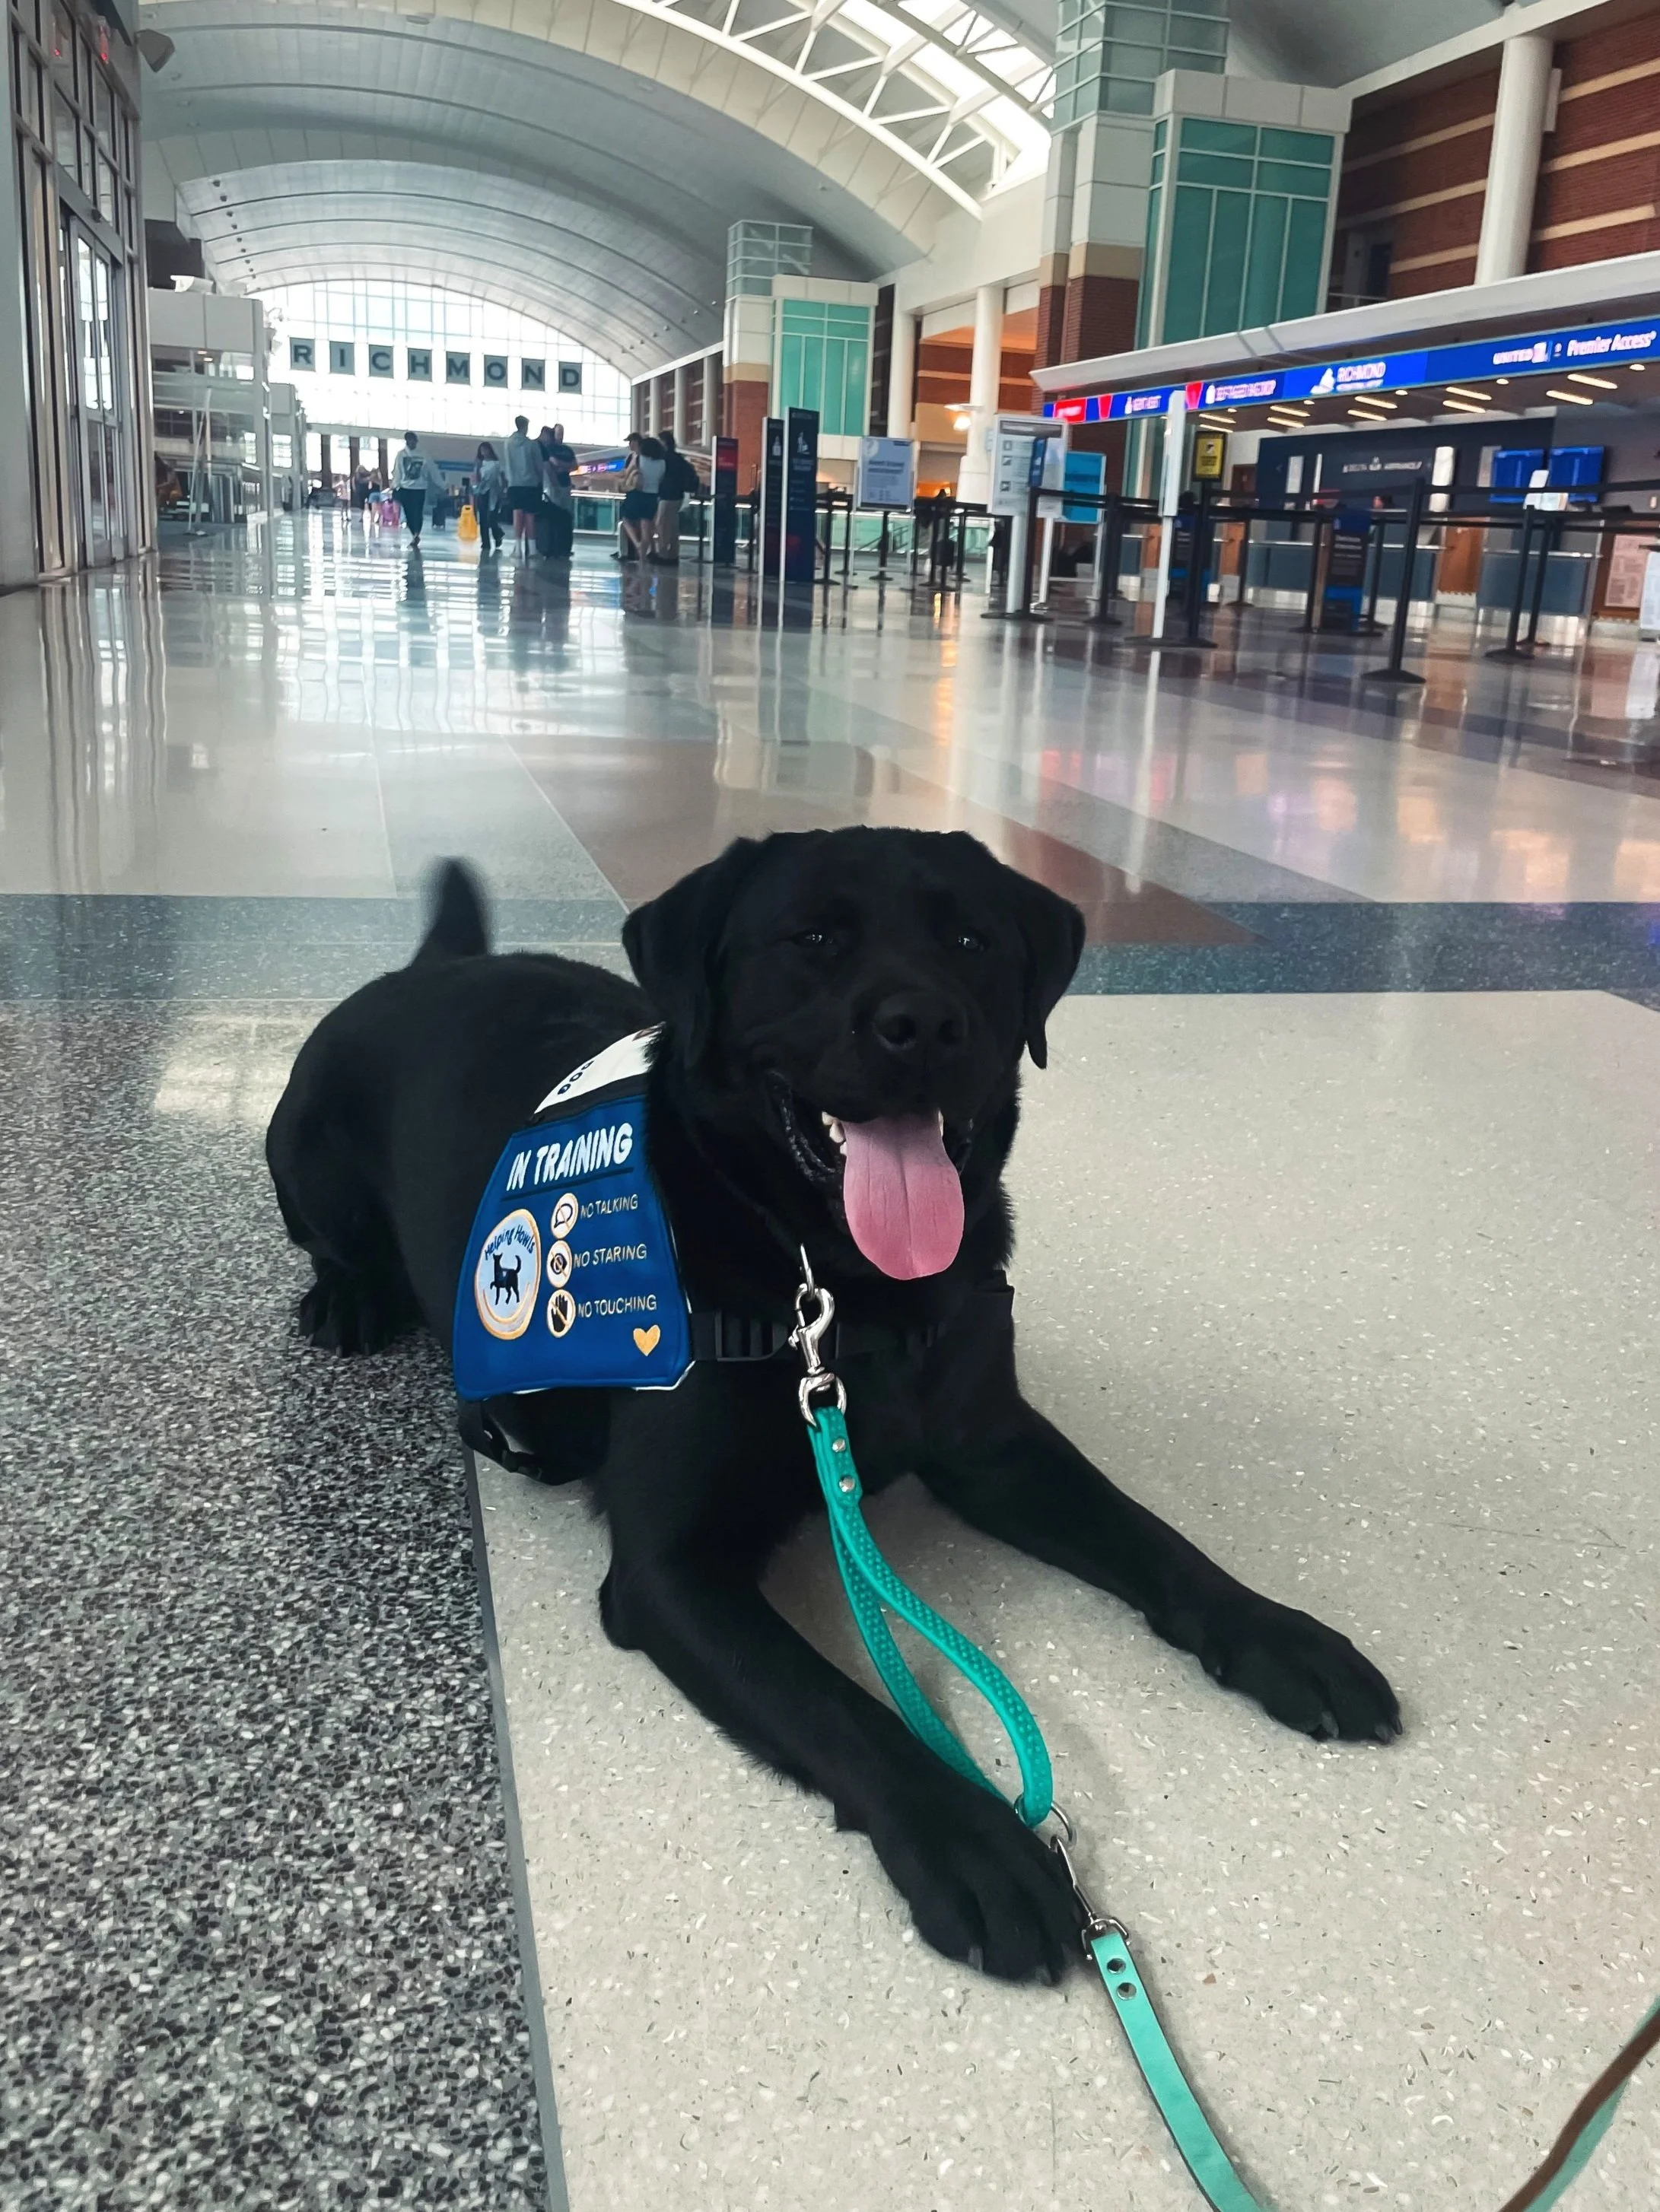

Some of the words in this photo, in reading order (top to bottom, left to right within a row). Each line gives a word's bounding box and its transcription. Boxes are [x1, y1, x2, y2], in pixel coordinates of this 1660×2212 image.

[1567, 336, 1612, 357] Premier
[293, 345, 580, 387] RICHMOND
[506, 1149, 532, 1191] IN
[534, 1122, 633, 1185] TRAINING
[580, 1203, 594, 1220] NO
[595, 1193, 638, 1216] TALKING
[484, 1226, 515, 1260] Helping
[514, 1223, 536, 1254] Howls
[573, 1251, 590, 1269] NO
[592, 1243, 647, 1266] STARING
[578, 1301, 593, 1318] NO
[593, 1294, 657, 1317] TOUCHING
